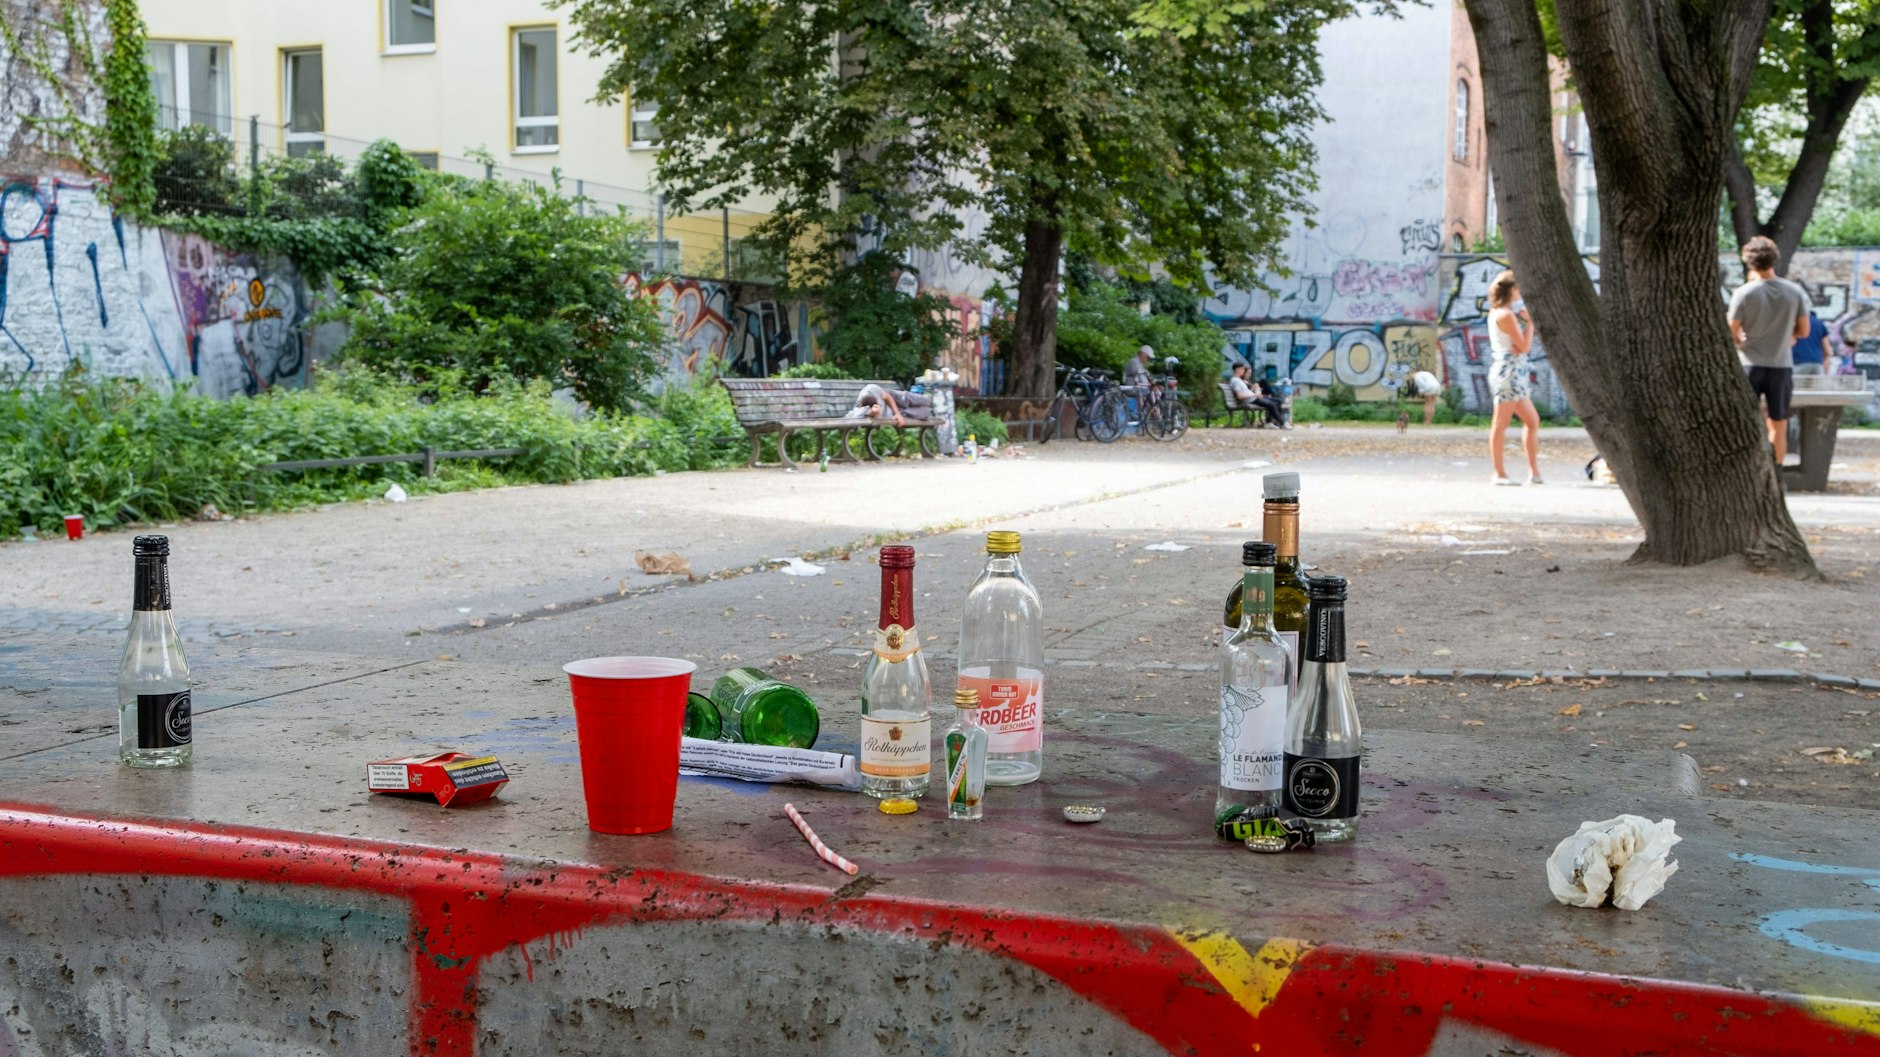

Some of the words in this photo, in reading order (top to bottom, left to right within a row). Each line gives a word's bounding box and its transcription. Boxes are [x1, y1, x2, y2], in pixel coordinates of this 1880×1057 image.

[1318, 607, 1328, 657] VESCOVINO
[1000, 720, 1035, 730] GESCHMACK
[864, 737, 927, 757] Rotkäppchen
[1233, 754, 1242, 762] LE
[1244, 754, 1282, 762] FLAMAND
[1233, 762, 1281, 776] BLANC
[1294, 778, 1331, 796] Secco
